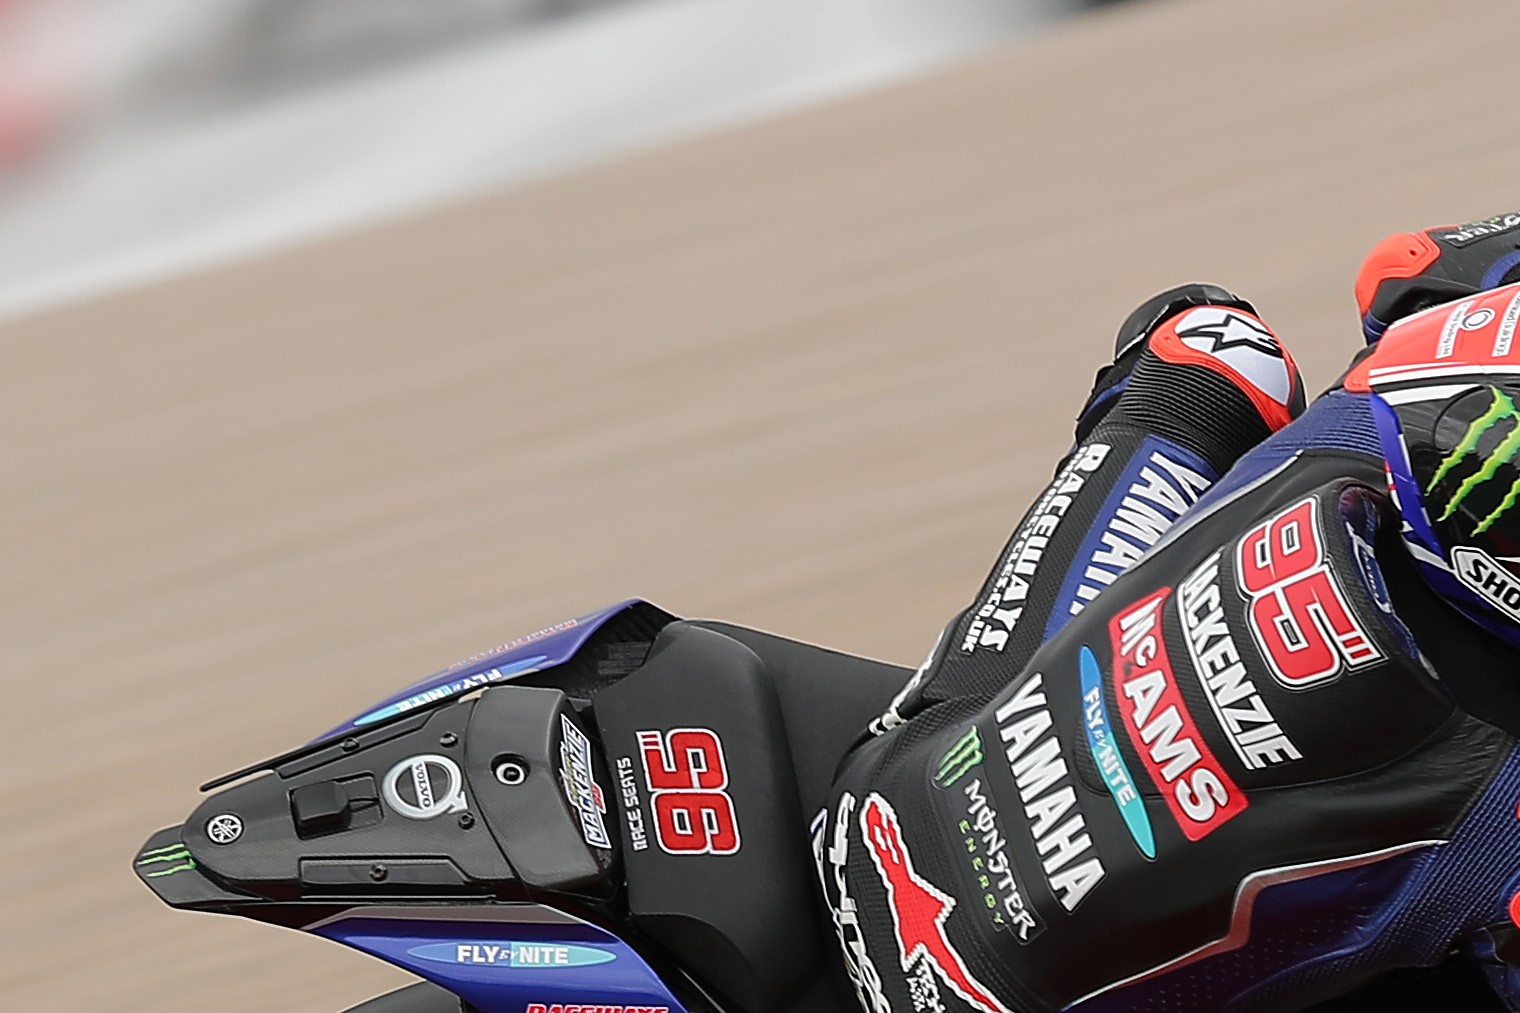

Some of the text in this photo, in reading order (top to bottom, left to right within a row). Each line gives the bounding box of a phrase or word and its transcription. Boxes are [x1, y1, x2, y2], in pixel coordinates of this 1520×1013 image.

[979, 443, 1111, 652] RACEWAYS
[1067, 451, 1212, 616] YAMA
[1238, 496, 1386, 687] 95
[396, 685, 454, 712] NITE
[462, 668, 504, 690] FLY
[1118, 595, 1230, 823] McAMS
[413, 761, 433, 808] VOLVO
[566, 723, 606, 843] MACKENZIE
[616, 756, 640, 808] SEATS
[636, 727, 741, 855] 95
[995, 671, 1106, 912] YAMAHA
[1082, 686, 1105, 731] FLY
[1097, 744, 1138, 808] NITE
[957, 817, 1005, 925] ENERGY
[963, 777, 1037, 941] MONSTER
[457, 945, 500, 963] FLY
[519, 946, 569, 964] NITE
